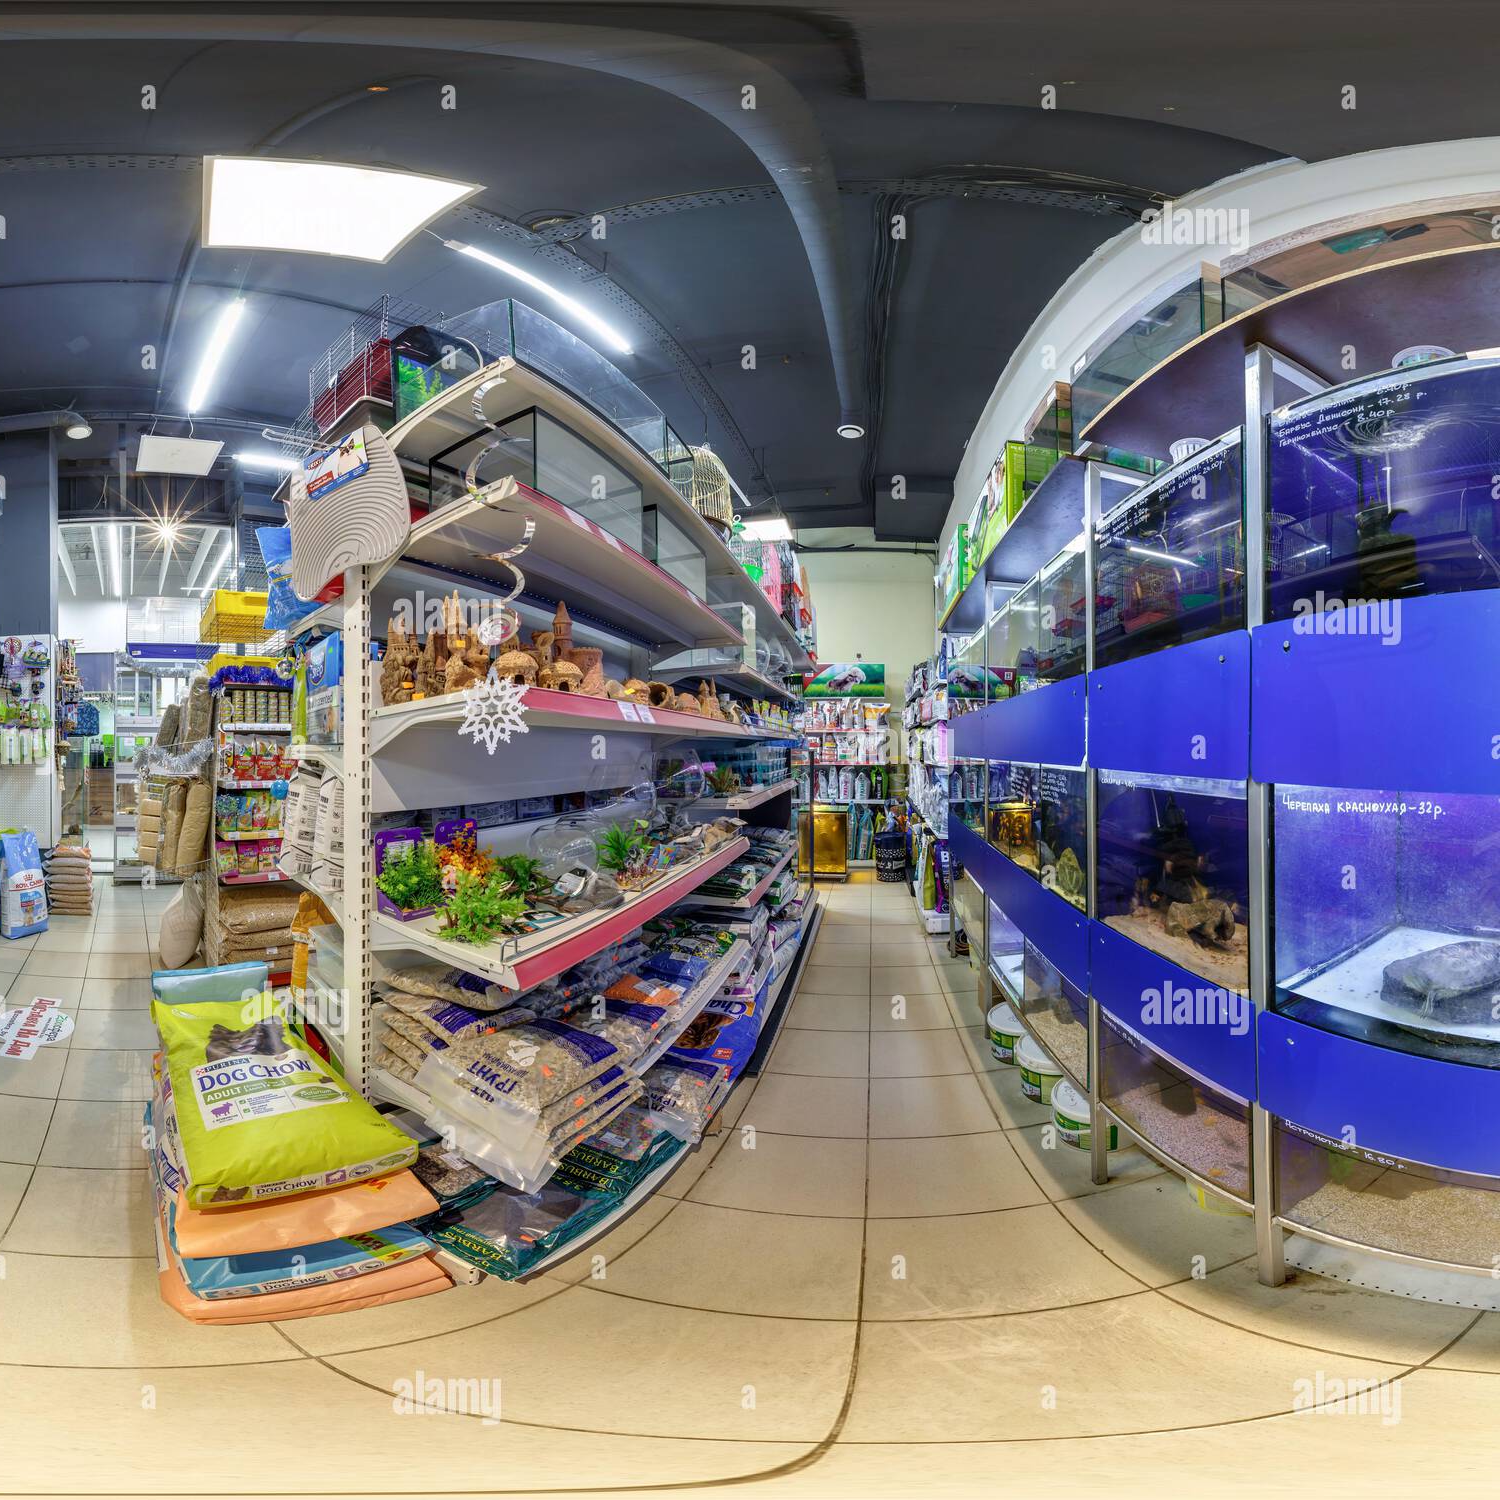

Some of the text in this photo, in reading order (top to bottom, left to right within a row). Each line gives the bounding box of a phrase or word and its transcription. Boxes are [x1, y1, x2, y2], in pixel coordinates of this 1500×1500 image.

[197, 1068, 248, 1092] DOG
[248, 1059, 312, 1078] CHOW
[204, 1057, 251, 1073] PURINA
[466, 1060, 518, 1095] ГРУНТ
[206, 1086, 241, 1102] ADULT
[569, 1149, 620, 1173] BARBUS
[255, 1178, 318, 1196] DOG CHOW
